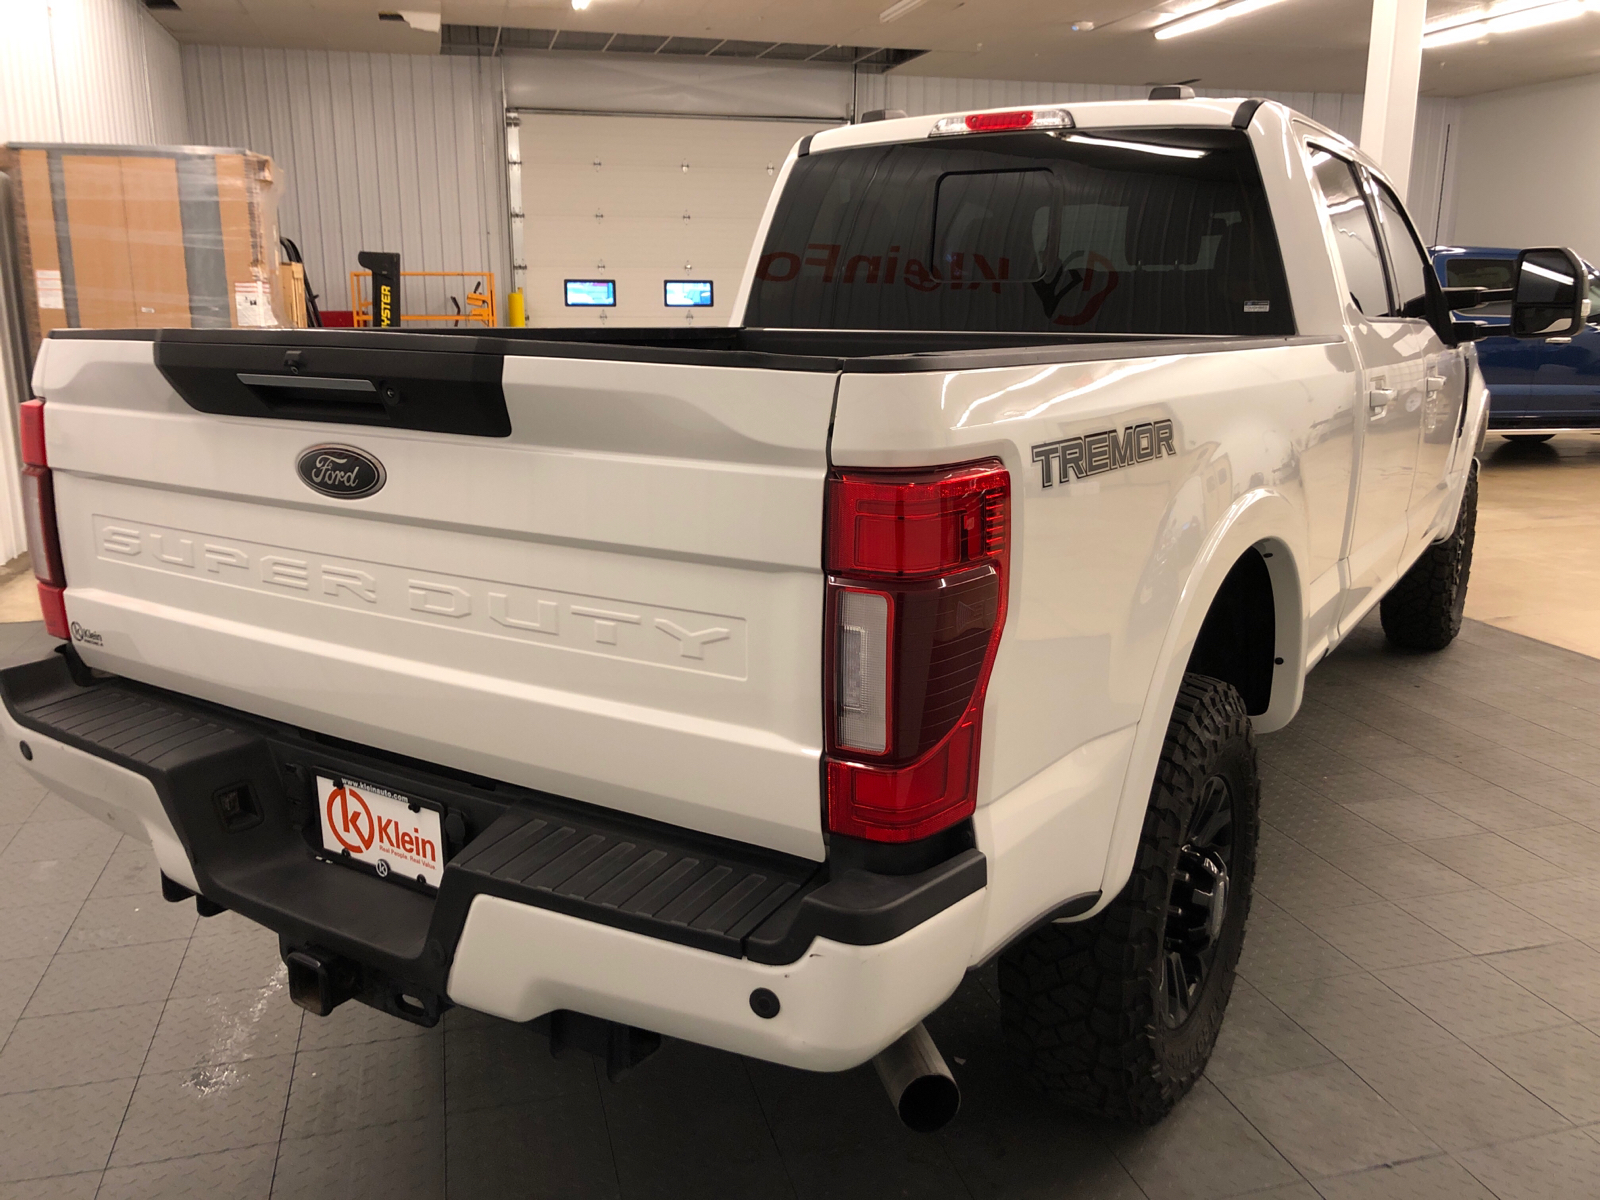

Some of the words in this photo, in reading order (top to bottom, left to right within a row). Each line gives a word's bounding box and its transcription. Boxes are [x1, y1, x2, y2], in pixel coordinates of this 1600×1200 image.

[381, 285, 391, 328] YSTER
[311, 454, 360, 487] Ford
[1031, 418, 1176, 488] TREMOR
[102, 525, 377, 604] SUPER
[408, 579, 731, 660] DUTY
[341, 777, 409, 804] www.kleinauto.com
[377, 815, 436, 862] Klein
[379, 844, 391, 855] Real
[409, 855, 421, 866] Real
